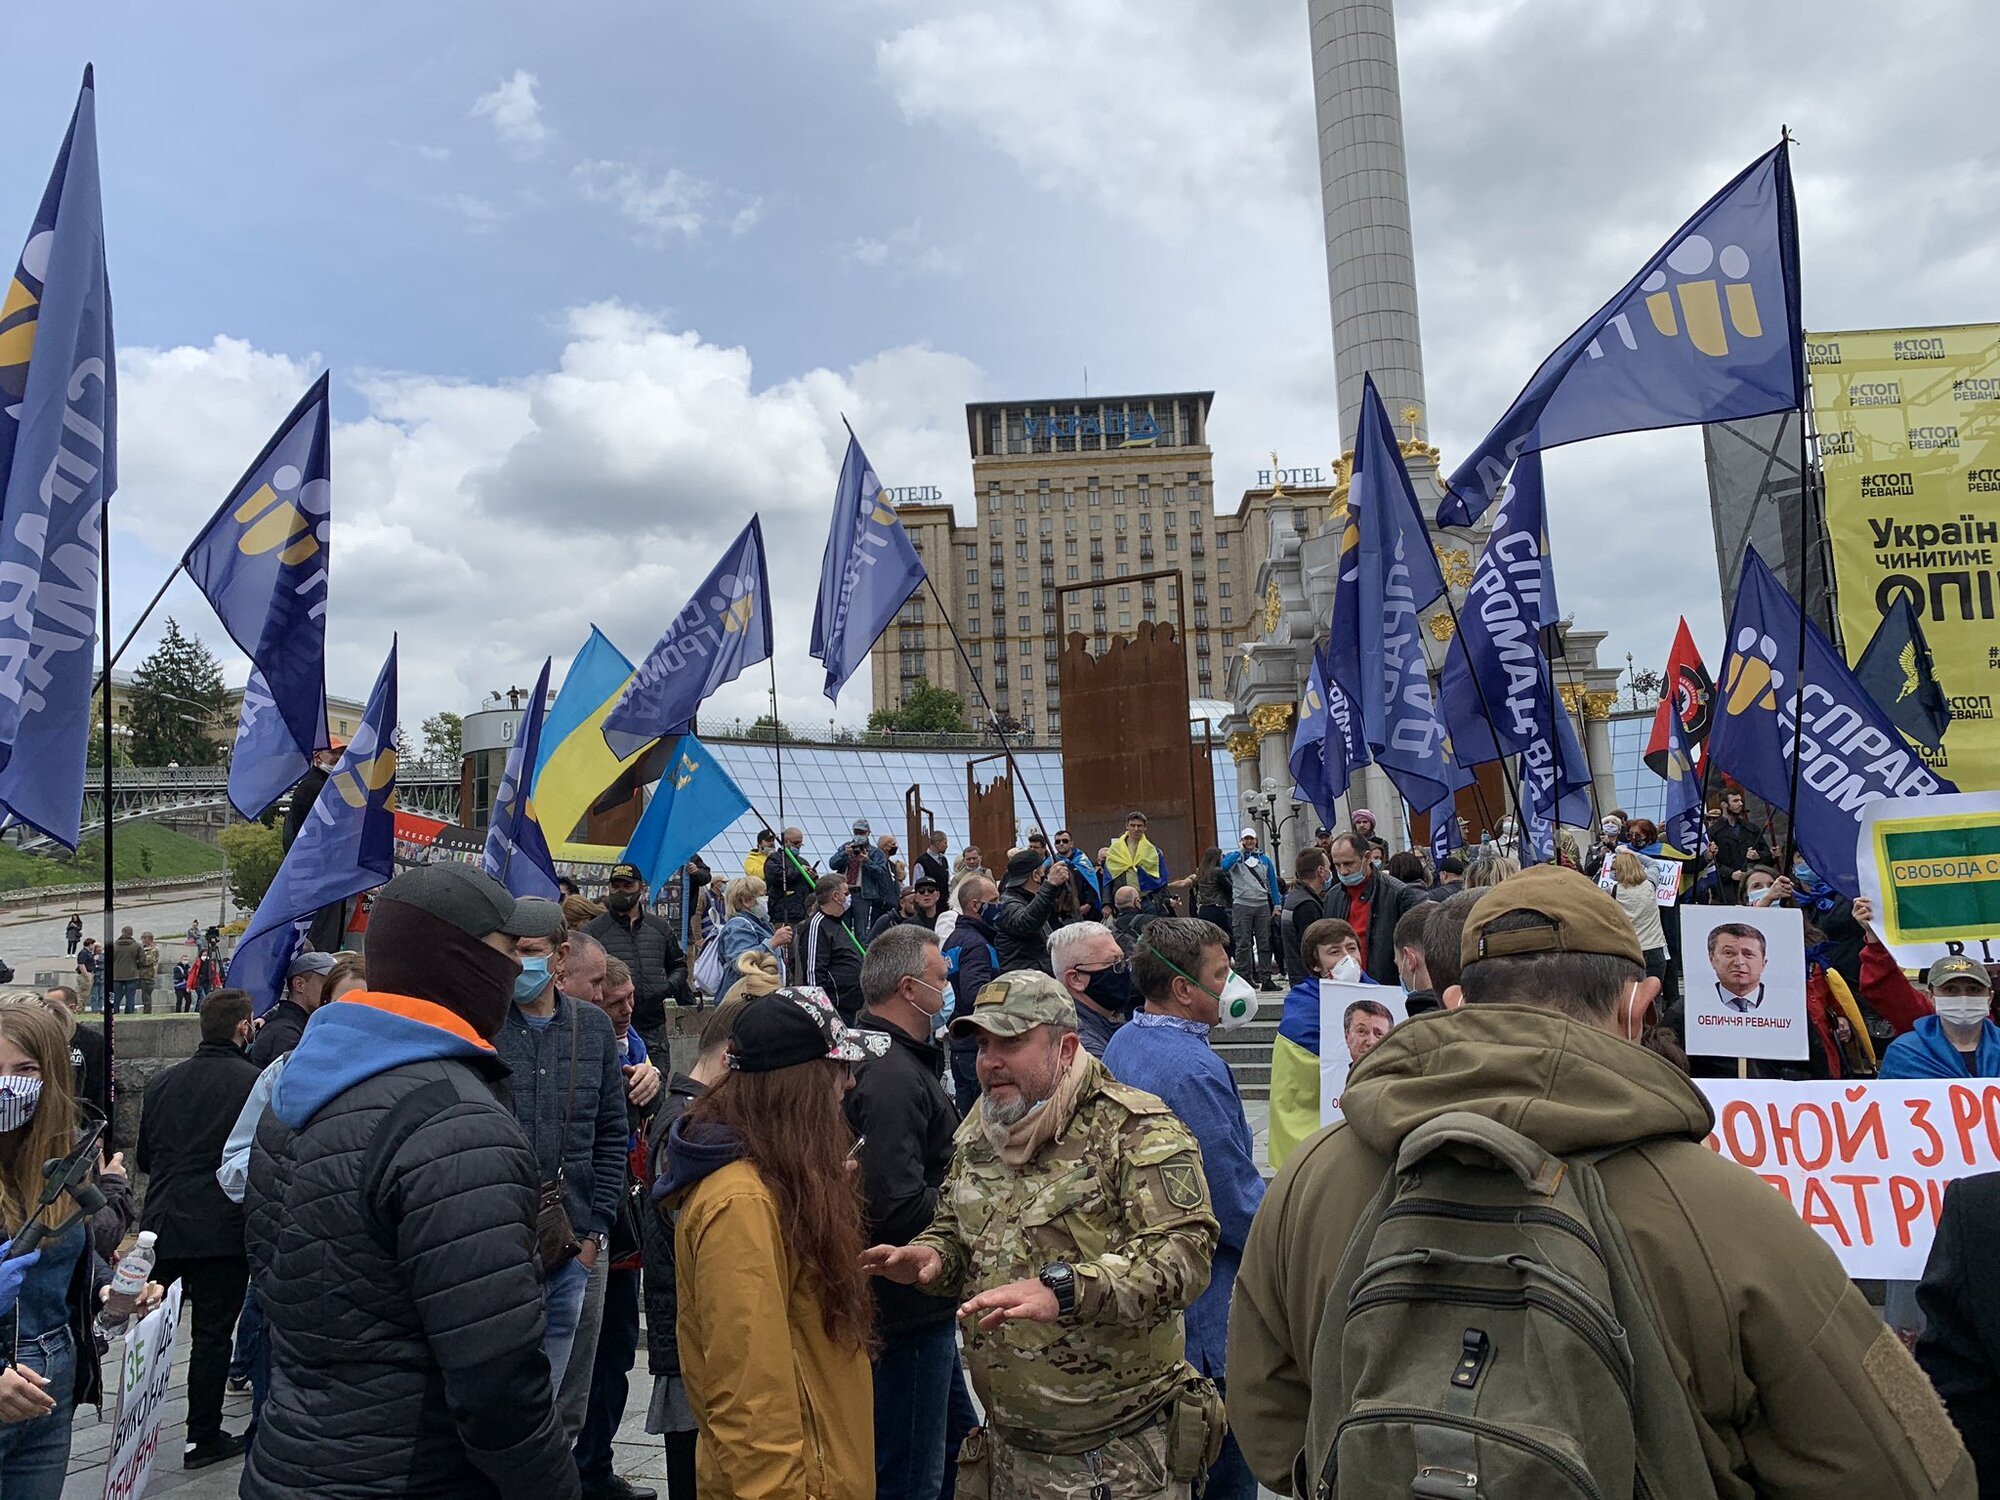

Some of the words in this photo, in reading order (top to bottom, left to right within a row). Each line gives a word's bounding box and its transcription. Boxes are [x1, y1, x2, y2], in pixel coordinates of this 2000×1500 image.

[1807, 344, 1840, 356] ТОП
[1893, 338, 1943, 352] #СТОП
[1895, 350, 1945, 361] РЕВАНШ
[1850, 383, 1899, 396] #СТОП
[1850, 396, 1901, 406] РЕВАНШ
[1023, 408, 1162, 438] УКРАЇНА
[1820, 431, 1853, 446] ТОП
[1908, 427, 1958, 440] #СТОП
[1909, 439, 1960, 450] РЕВАНШ
[1257, 467, 1326, 485] HOTEL
[1861, 473, 1913, 487] #СТОП
[1968, 469, 2000, 482] #СТО
[1861, 486, 1914, 498] РЕВАНШ
[1968, 482, 2000, 493] РЕВА
[1875, 549, 1993, 570] ЧИНИТИМЕ
[1875, 570, 2000, 622] ОПІ
[1950, 708, 1994, 721] ЕВАНШ
[1910, 744, 1947, 758] ТОП
[1895, 862, 1982, 881] СВОБОДА
[1697, 1015, 1743, 1026] ОБЛИЧЧЯ
[1745, 1016, 1792, 1029] РЕВАНШУ
